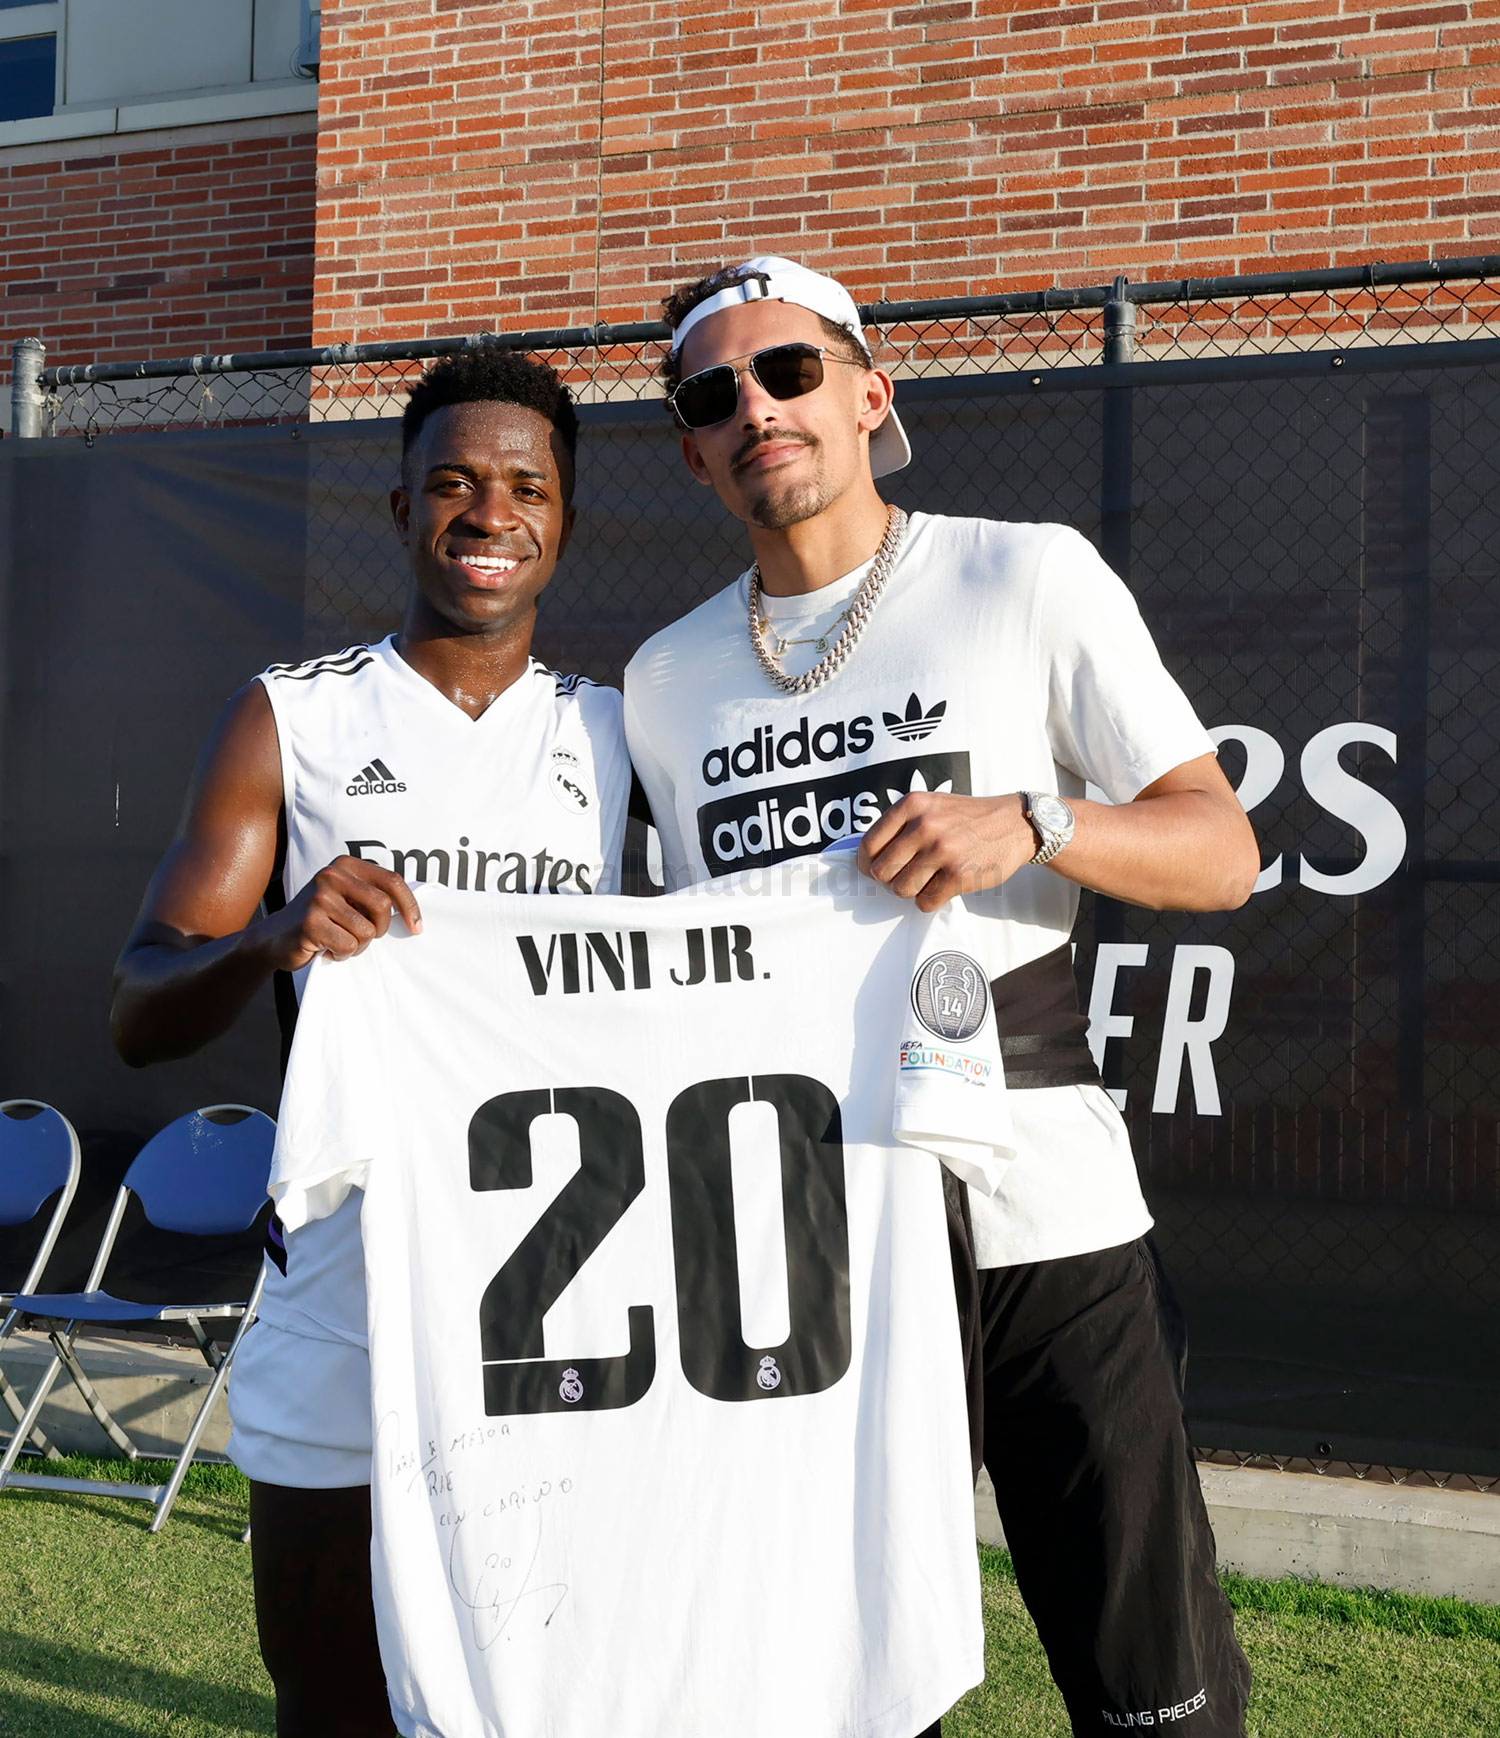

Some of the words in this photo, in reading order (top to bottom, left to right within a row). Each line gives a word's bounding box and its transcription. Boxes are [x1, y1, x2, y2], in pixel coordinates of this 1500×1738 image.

[702, 716, 875, 787] adidas
[346, 780, 407, 796] adidas
[1086, 722, 1407, 895] es
[712, 791, 883, 862] adidas
[516, 930, 651, 996] VINI
[670, 925, 771, 986] JR.
[941, 996, 963, 1017] 14
[1071, 943, 1235, 1116] ER
[900, 1041, 923, 1051] UEFA
[900, 1052, 992, 1077] FOUNDATION
[468, 1073, 853, 1417] 20
[1158, 1688, 1206, 1723] PIECES
